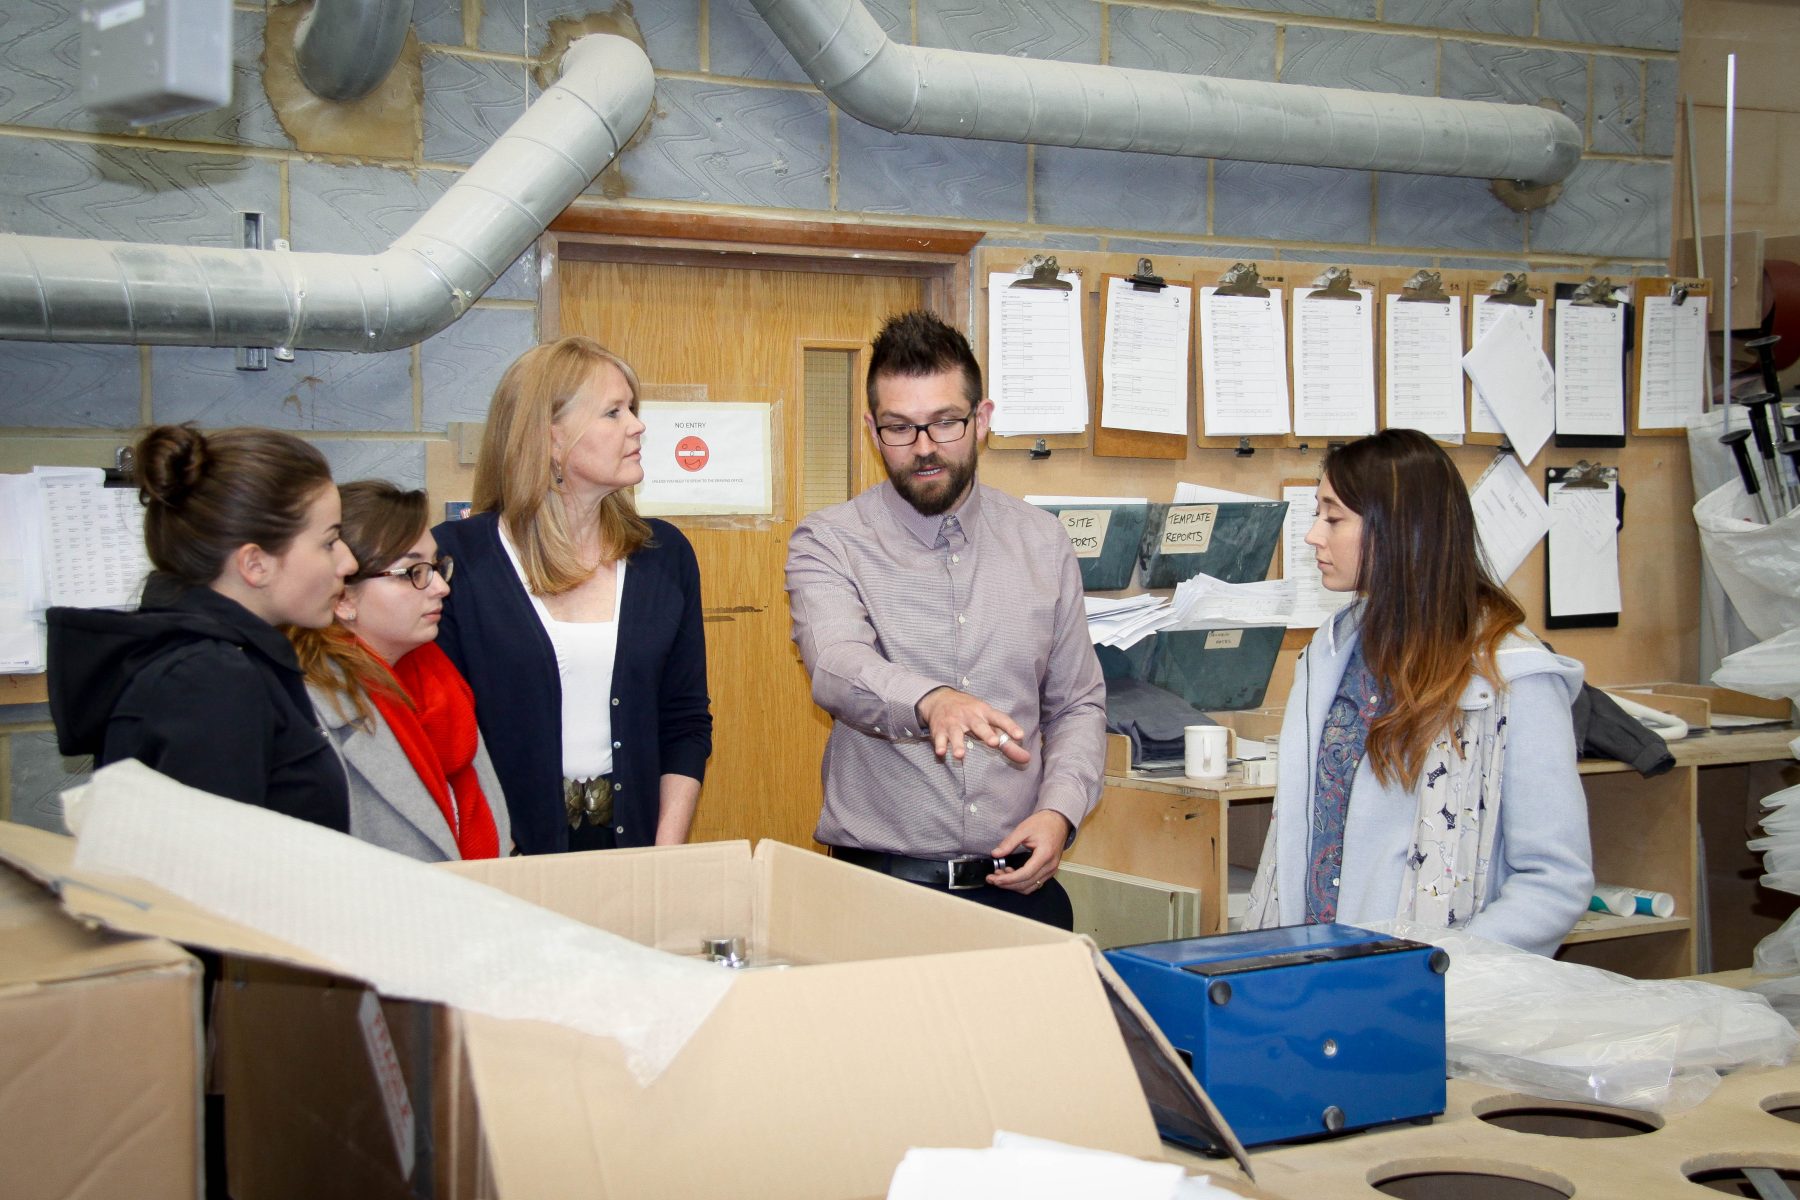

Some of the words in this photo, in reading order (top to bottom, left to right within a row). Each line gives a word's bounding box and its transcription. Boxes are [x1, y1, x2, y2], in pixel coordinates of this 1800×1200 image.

[1067, 517, 1096, 529] SITE
[1168, 512, 1212, 525] TEMPLATE
[1069, 536, 1098, 549] PORTS
[1165, 531, 1204, 543] REPORTS
